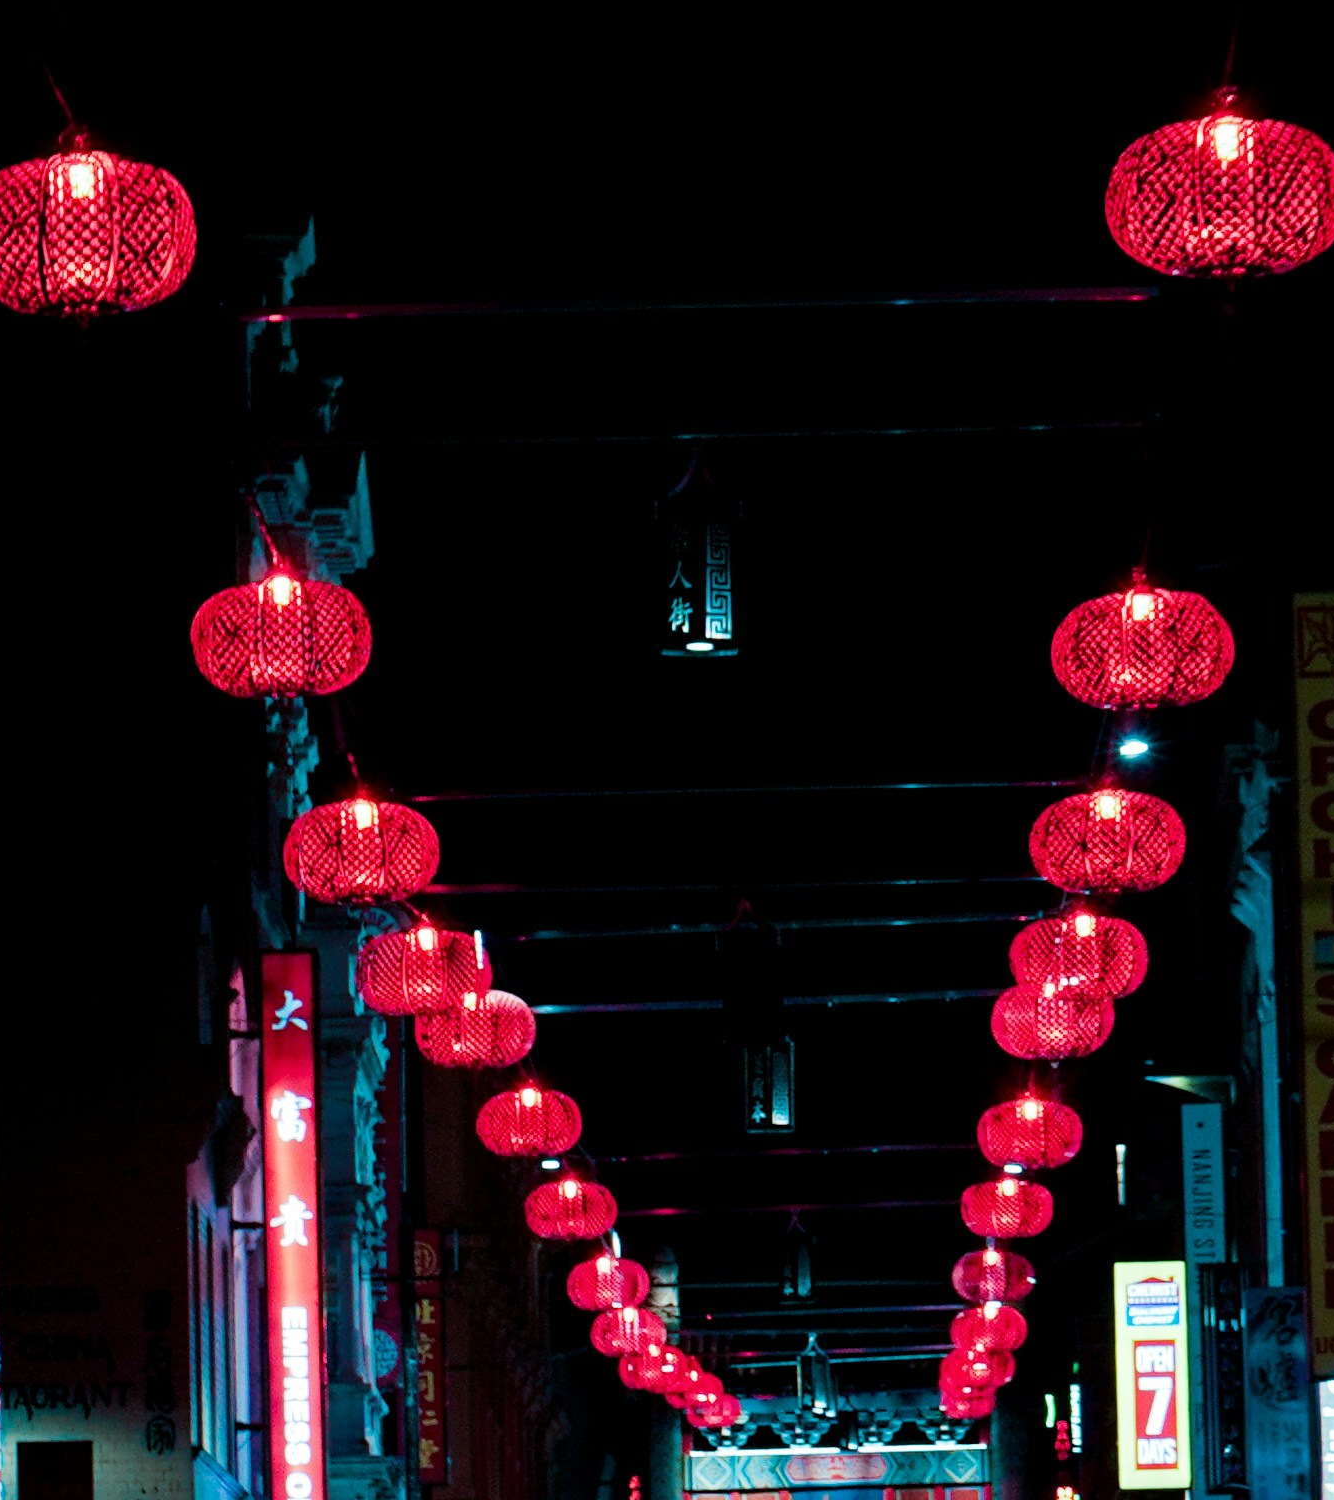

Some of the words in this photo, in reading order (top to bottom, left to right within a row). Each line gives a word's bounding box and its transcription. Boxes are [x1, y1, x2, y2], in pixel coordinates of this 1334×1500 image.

[1134, 1344, 1175, 1373] OPEN
[281, 1305, 312, 1466] EMPRESS
[1137, 1376, 1173, 1436] 7
[1137, 1437, 1177, 1465] DAYS
